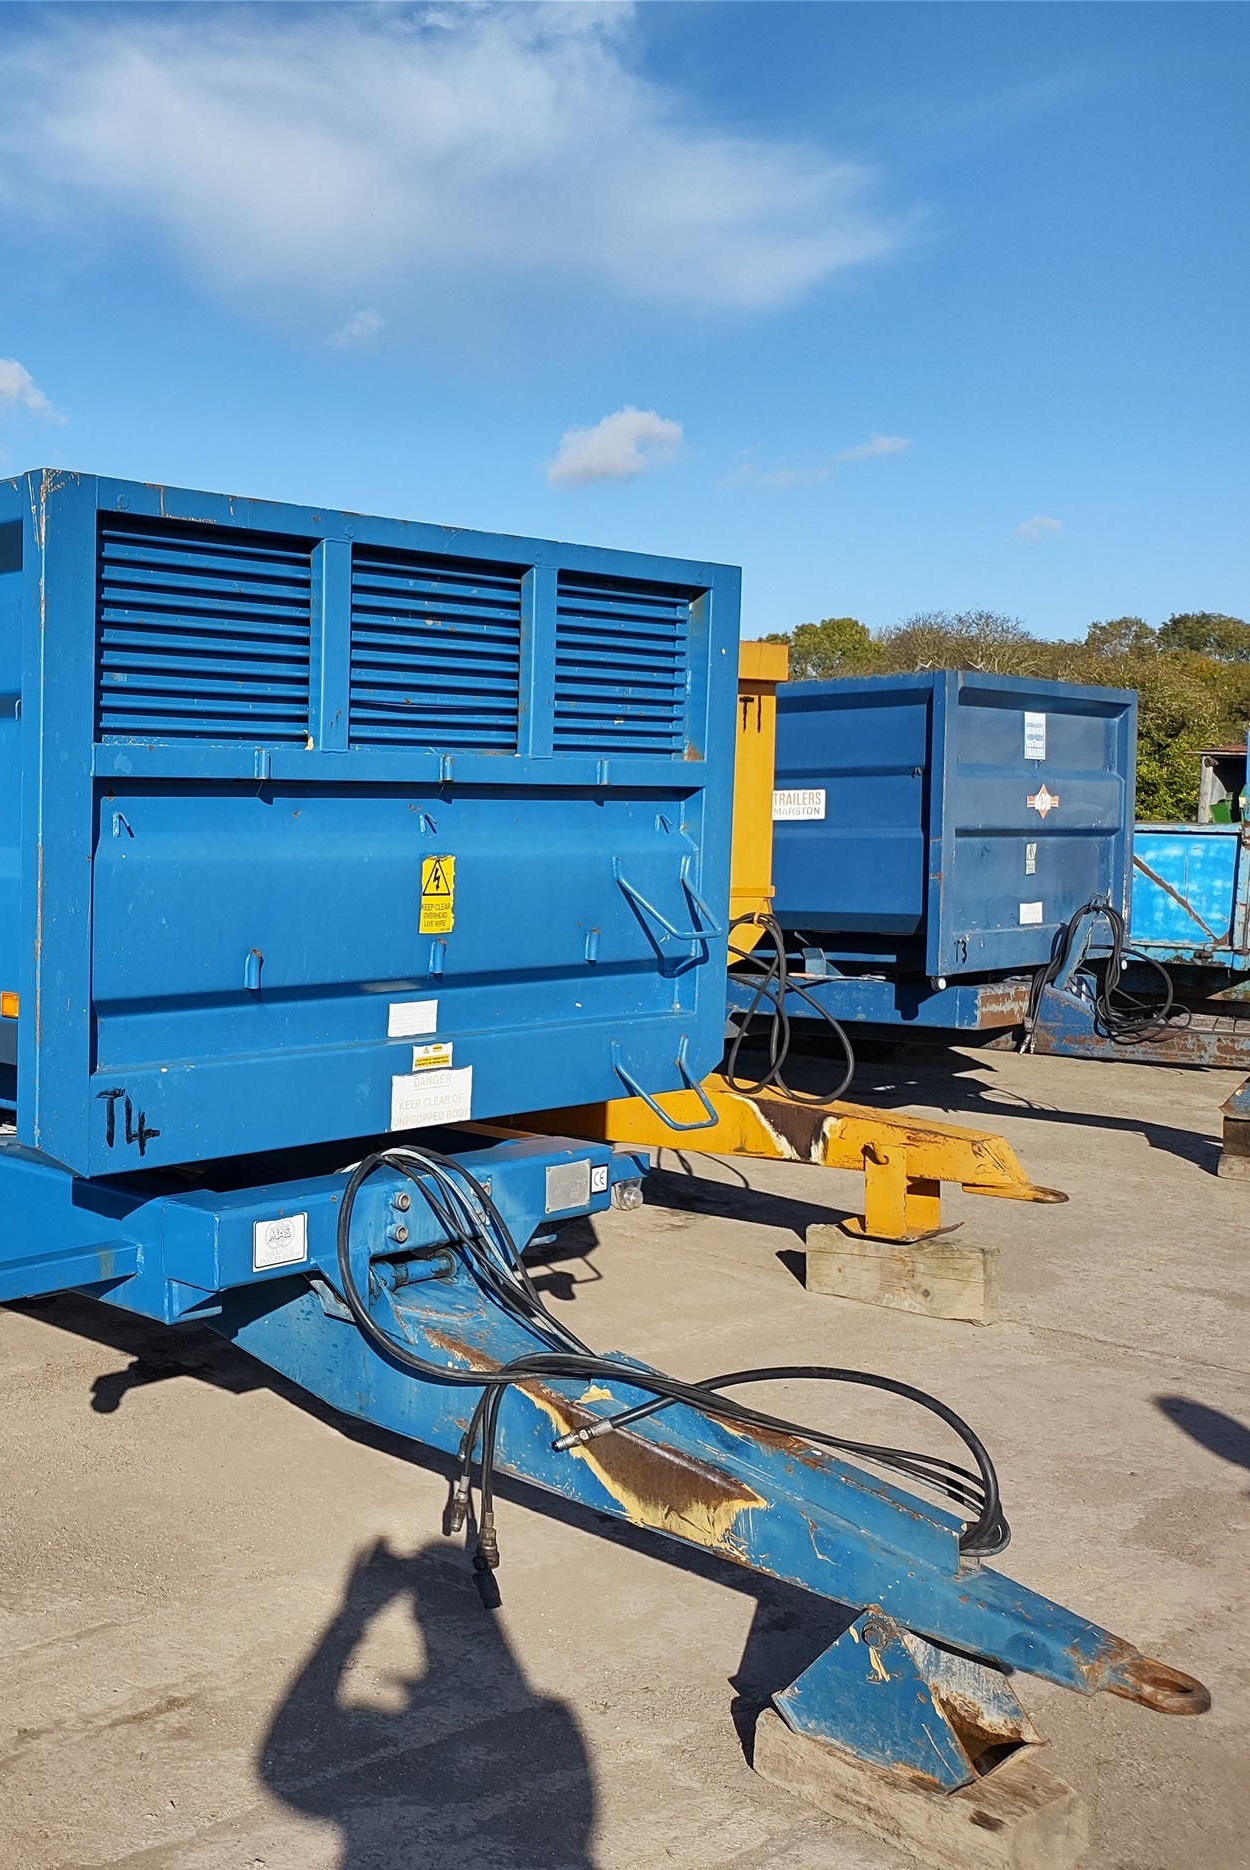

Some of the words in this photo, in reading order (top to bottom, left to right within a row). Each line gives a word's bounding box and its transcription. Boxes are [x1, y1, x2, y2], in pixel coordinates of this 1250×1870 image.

[773, 792, 821, 806] TRAILERS
[774, 807, 820, 816] MARSTON
[421, 903, 434, 911] KEEP
[435, 902, 451, 911] CLEAR
[423, 911, 448, 919] OVERHEAD
[424, 920, 434, 928] LIVE
[435, 919, 446, 927] WIRE
[413, 1073, 452, 1088] DANGER
[399, 1098, 421, 1112] KEEP
[422, 1094, 450, 1107] CLEAR
[452, 1092, 464, 1103] OF
[94, 1087, 161, 1157] T4
[393, 1110, 445, 1128] UNPROPPED
[446, 1107, 469, 1119] BODY
